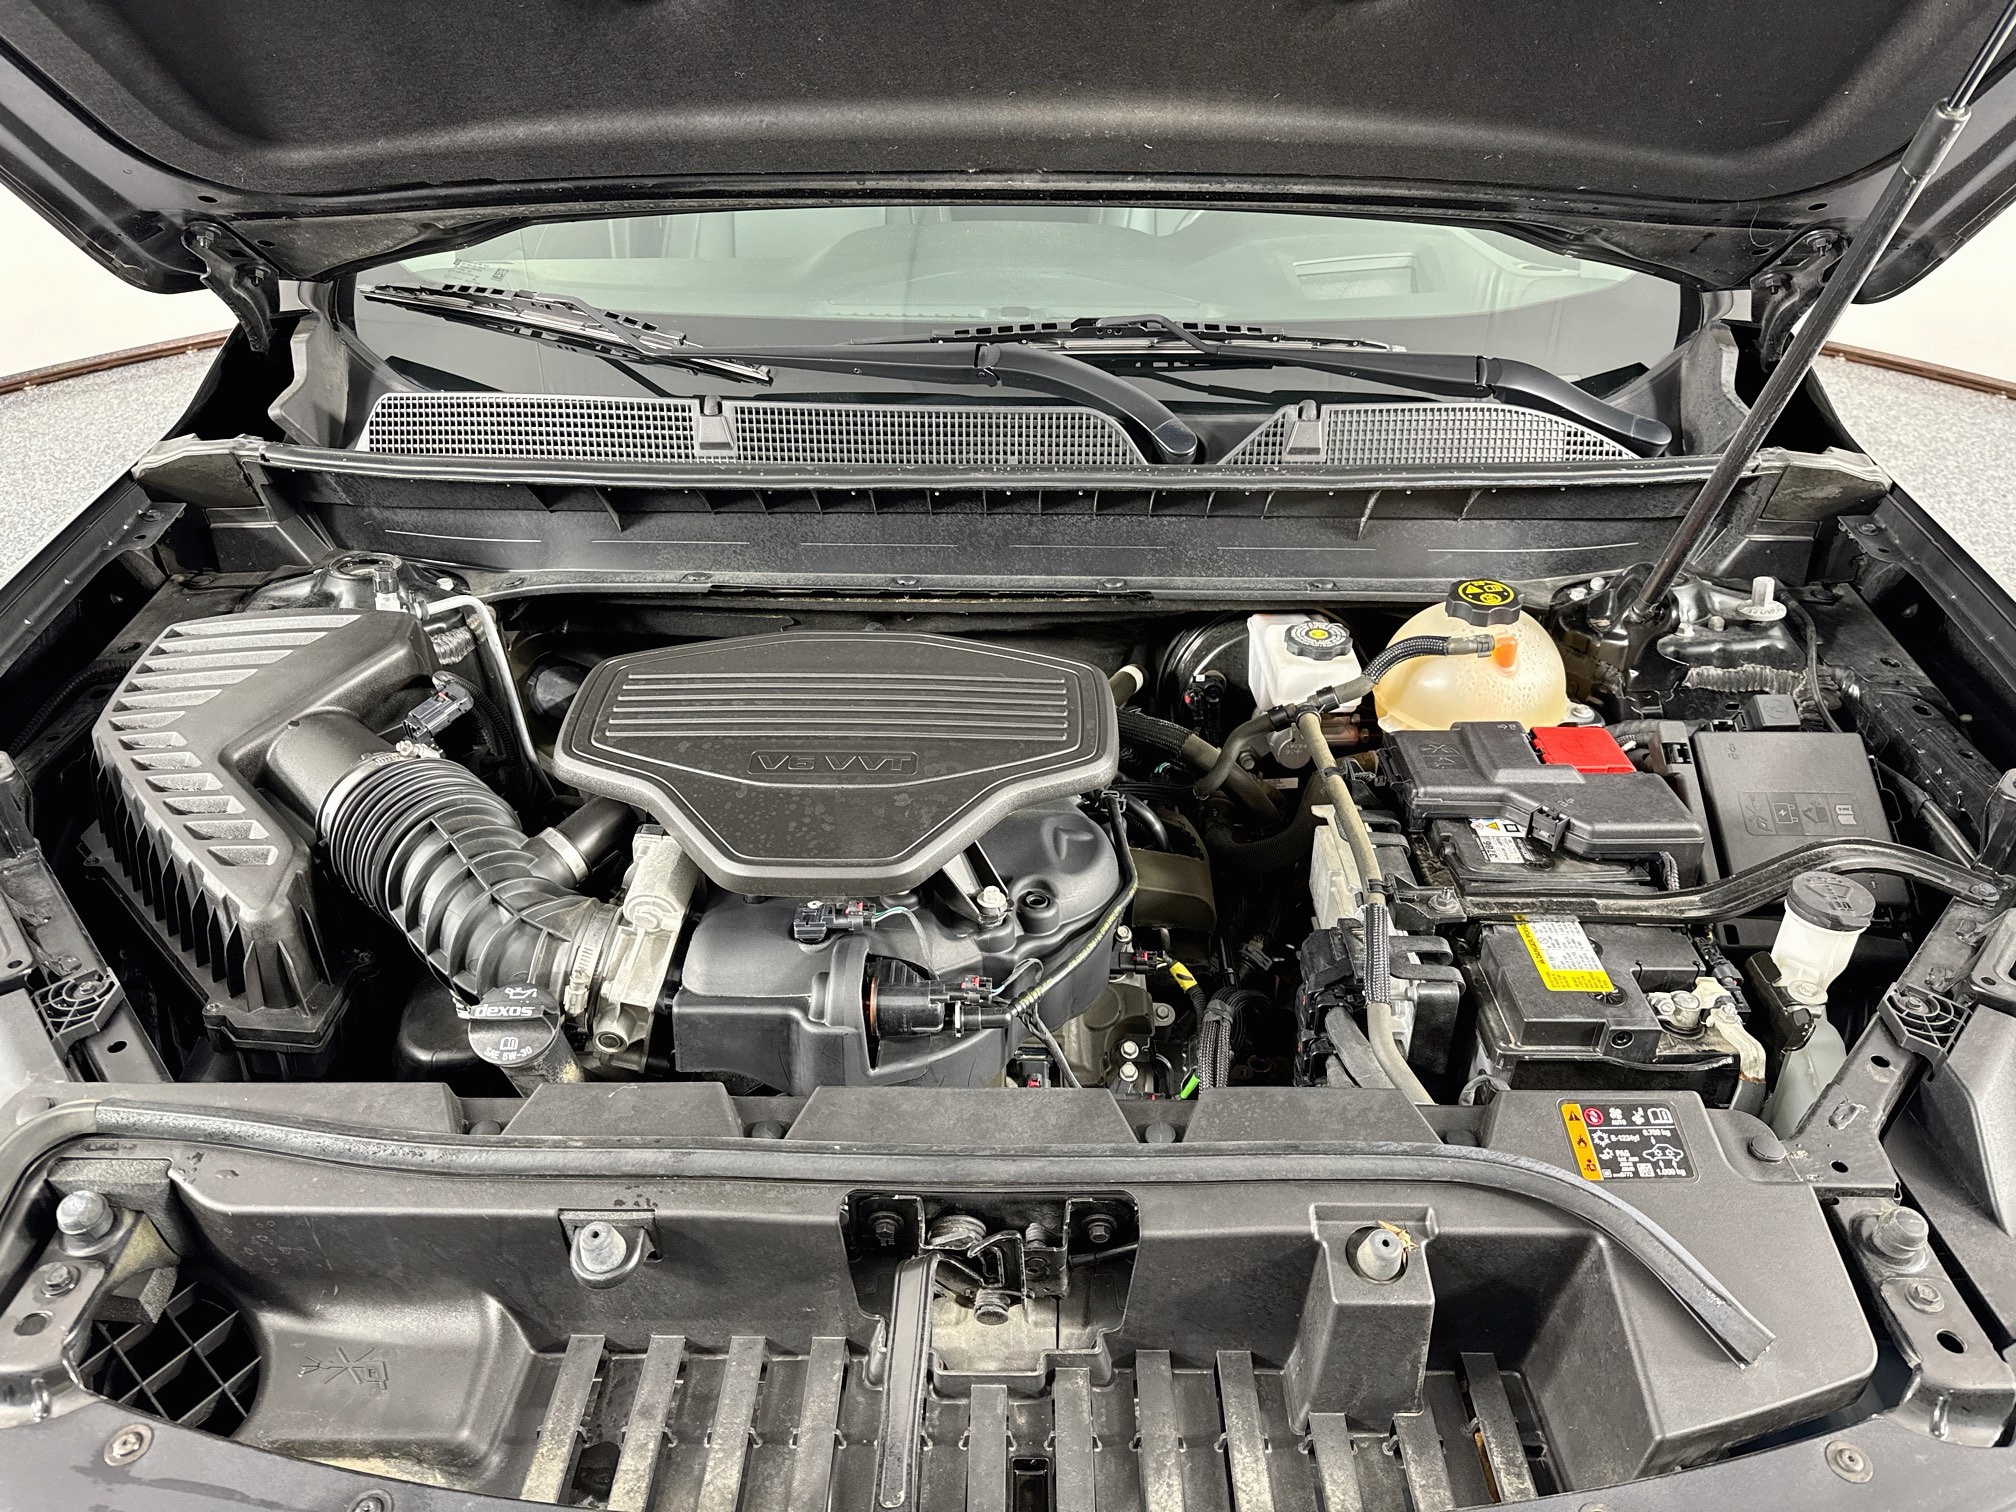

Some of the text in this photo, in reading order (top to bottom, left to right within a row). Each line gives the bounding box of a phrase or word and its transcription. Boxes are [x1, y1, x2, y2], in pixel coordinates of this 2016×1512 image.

[757, 755, 911, 771] V6 VVT
[474, 1003, 536, 1017] dexos
[483, 1045, 533, 1061] SAE 5W-30
